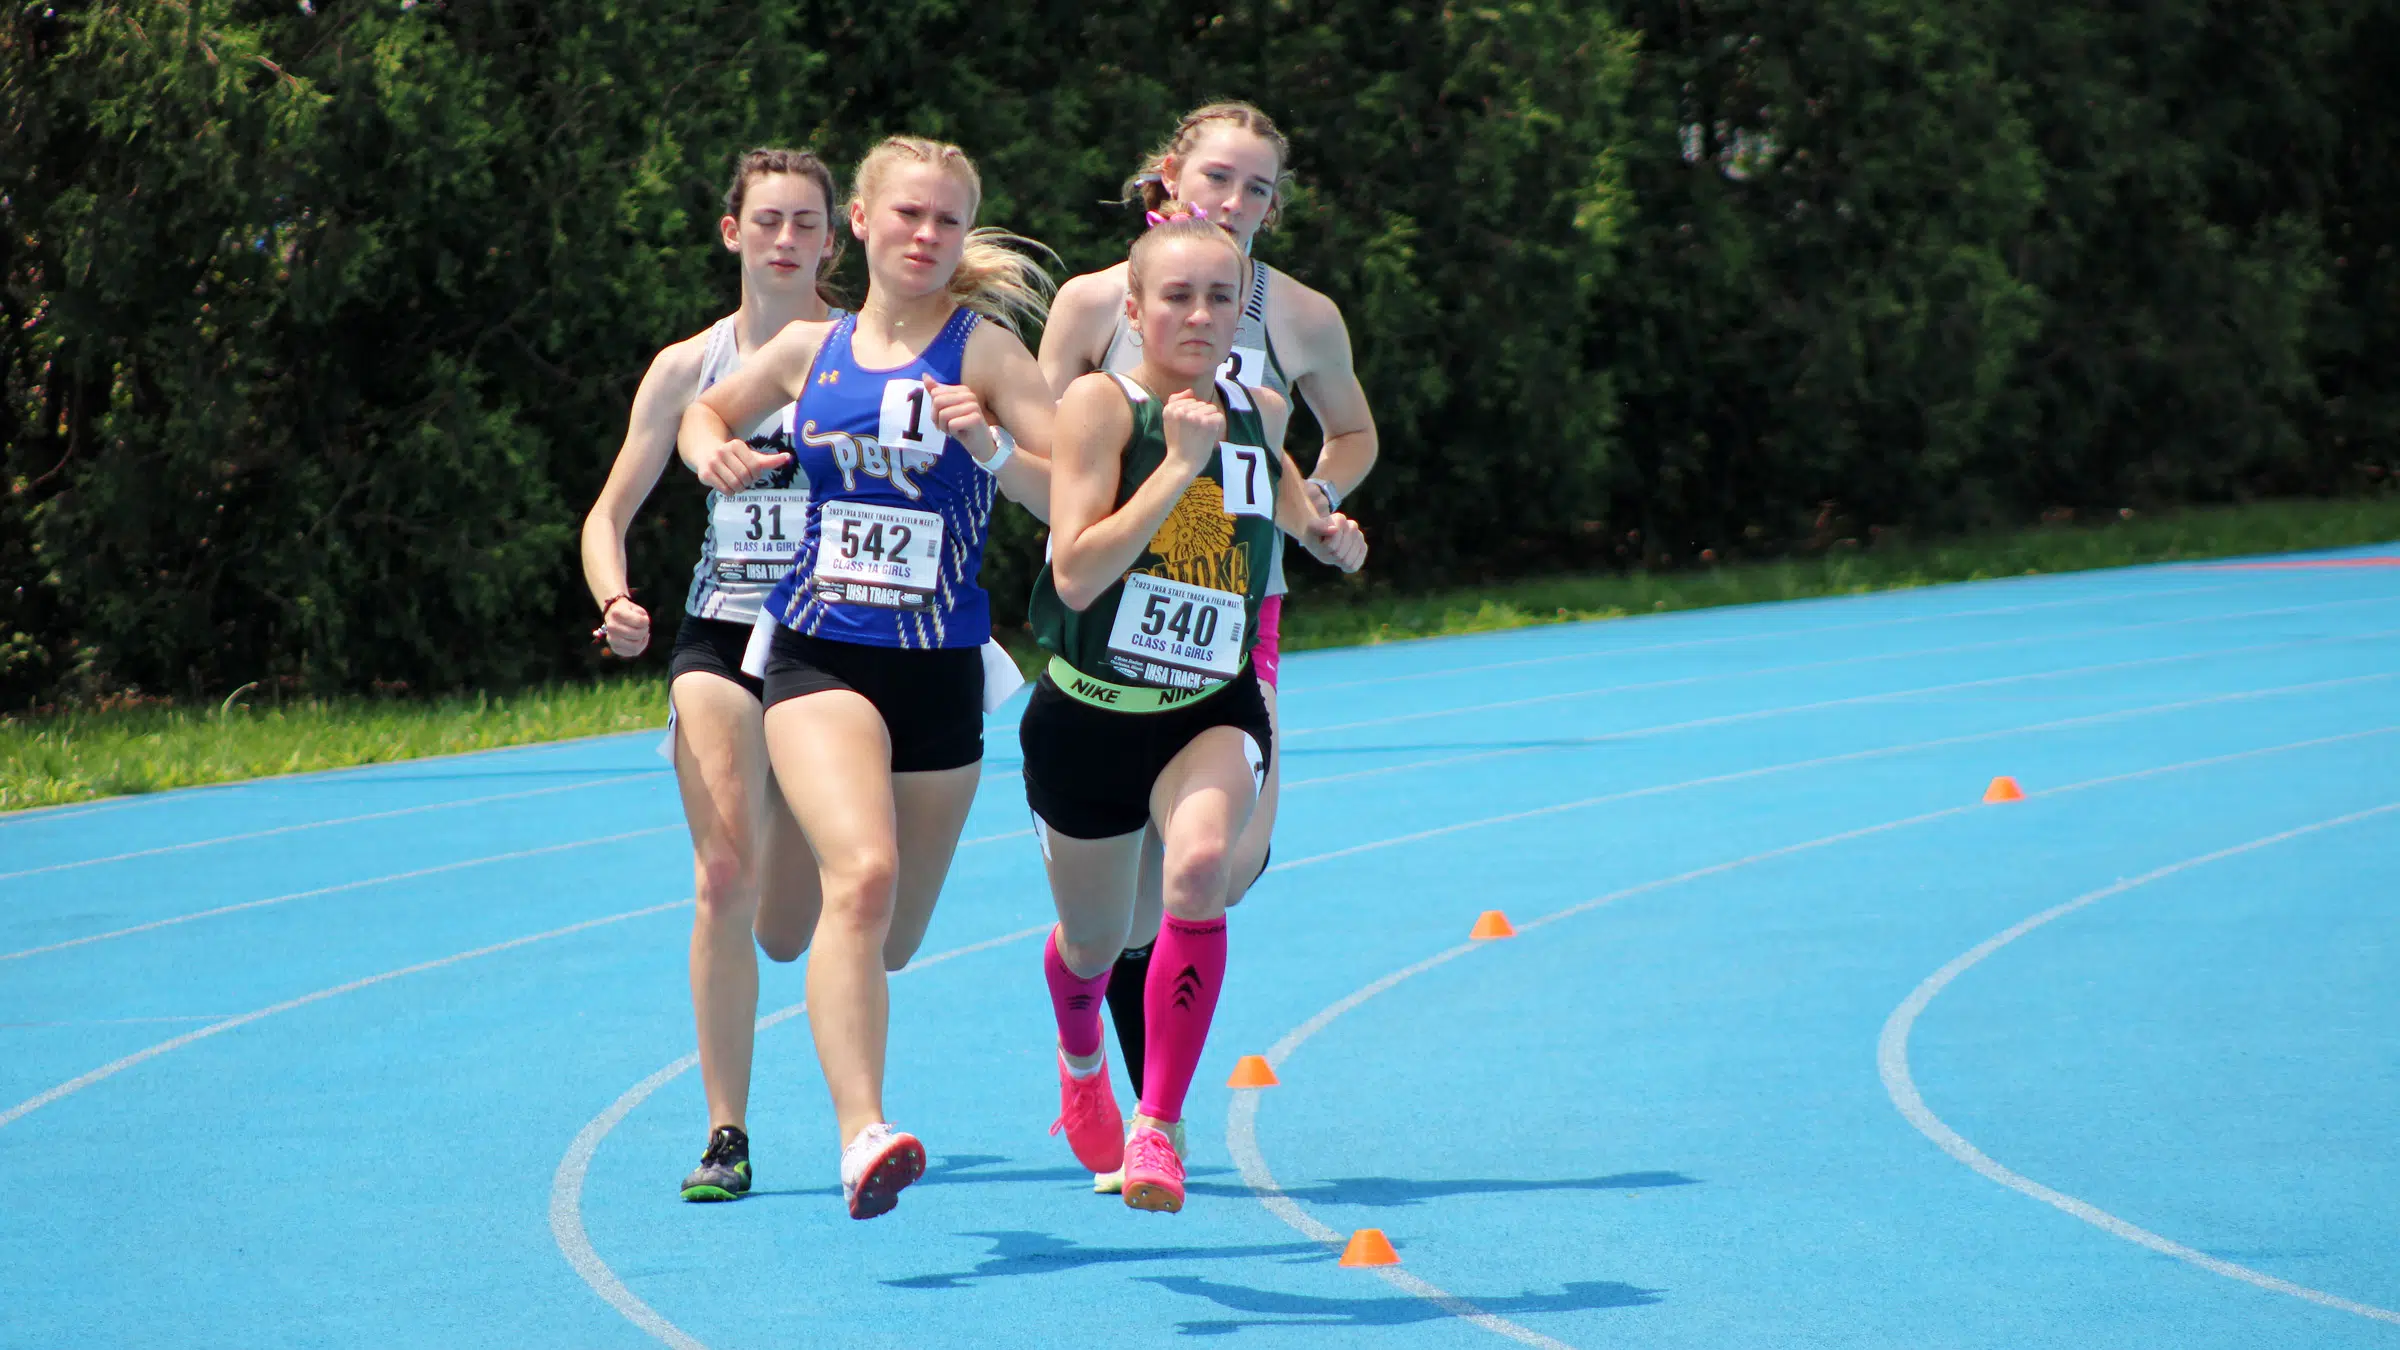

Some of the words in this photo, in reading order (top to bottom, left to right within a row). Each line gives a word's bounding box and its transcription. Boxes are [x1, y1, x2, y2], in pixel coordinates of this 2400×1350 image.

[902, 387, 924, 442] 1
[1236, 451, 1257, 505] 7
[744, 504, 786, 540] 31
[858, 511, 874, 519] STATE
[876, 513, 894, 522] TRACK
[902, 516, 917, 524] FIELD
[919, 518, 934, 526] MEET
[734, 542, 758, 552] CLASS
[762, 542, 772, 551] 1A
[776, 542, 801, 552] GIRL
[840, 518, 912, 564] 542
[746, 564, 768, 580] IHSA
[833, 558, 864, 572] CLASS
[868, 562, 879, 573] 1A
[882, 564, 911, 578] GIRLS
[1123, 542, 1250, 595] TOKA
[846, 584, 868, 602] IHSA
[869, 587, 901, 606] TRACK
[1134, 580, 1150, 590] 2023
[1168, 587, 1185, 598] STATE
[1186, 592, 1204, 602] TRACK
[1211, 596, 1226, 606] FIELD
[1140, 593, 1218, 647] 540
[1131, 633, 1167, 652] CLASS
[1170, 642, 1182, 656] 1A
[1184, 645, 1214, 662] GIRLS
[1144, 663, 1168, 684] IHSA
[1169, 668, 1202, 689] TRACK
[1070, 678, 1121, 704] NIKE
